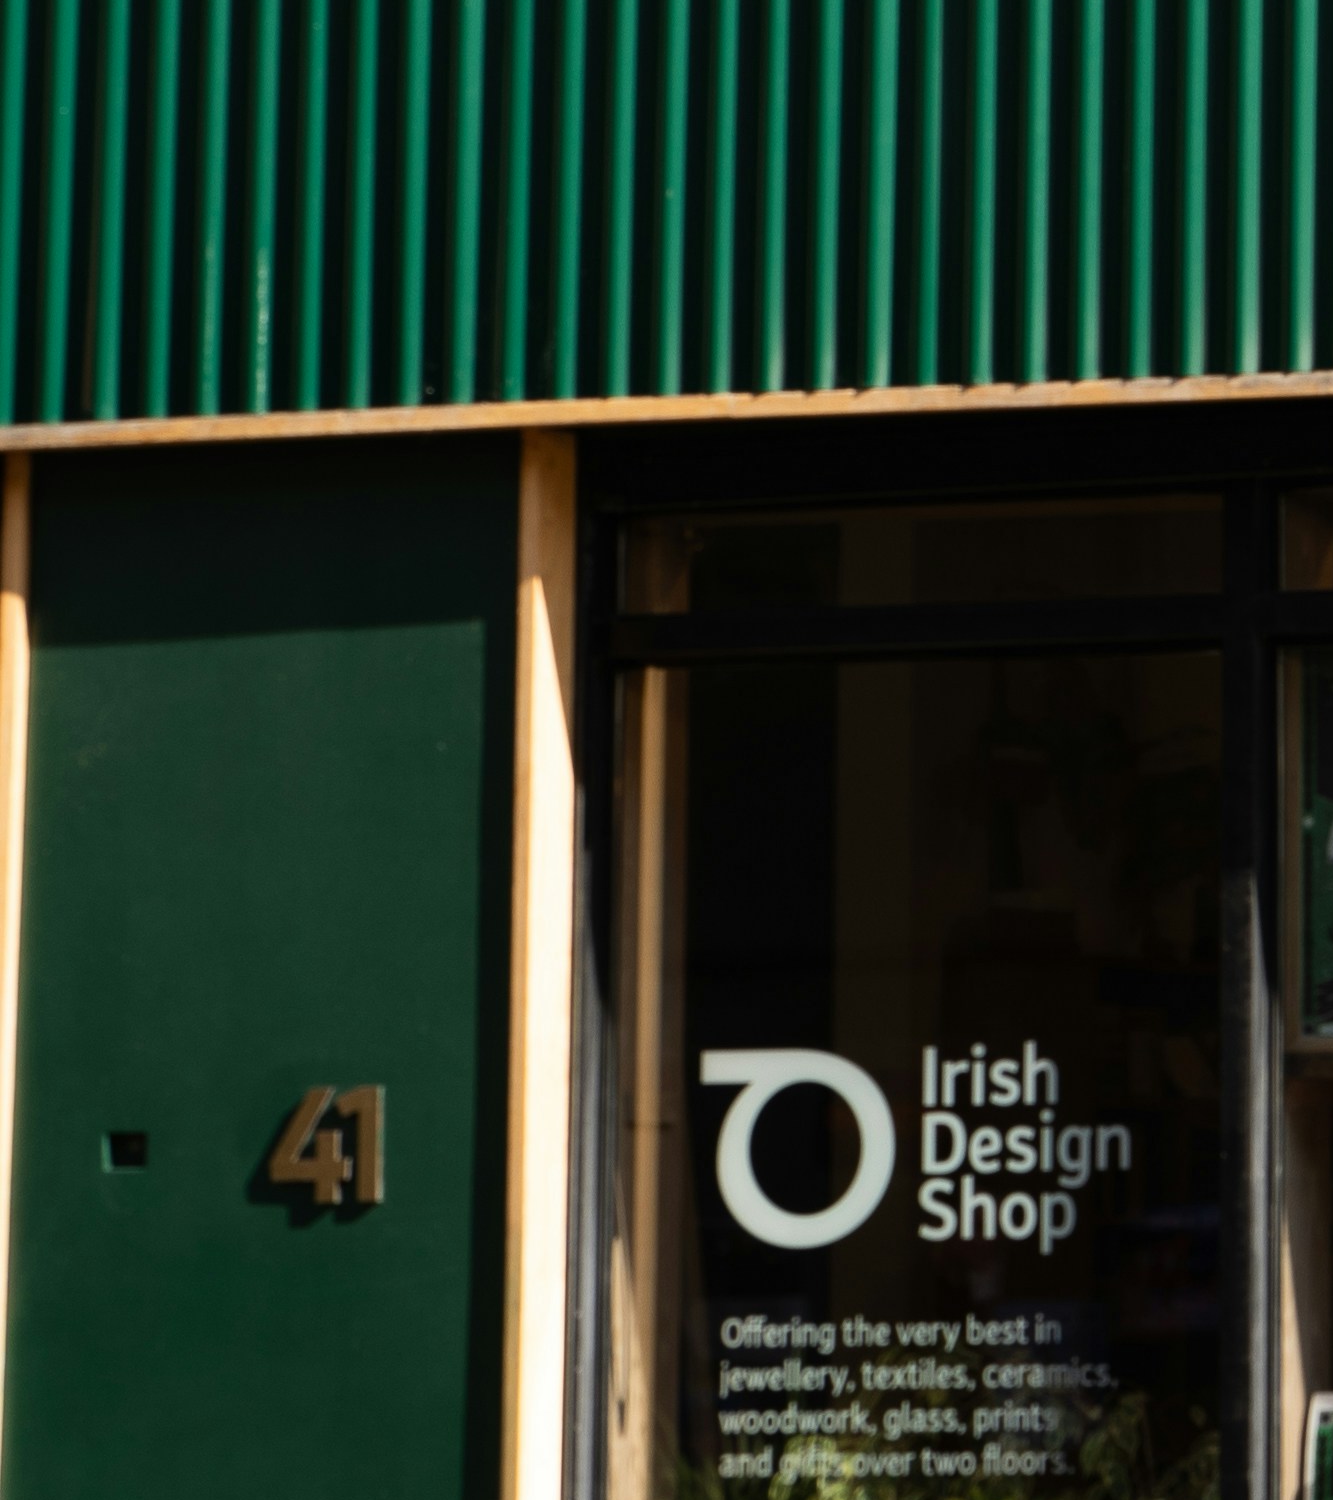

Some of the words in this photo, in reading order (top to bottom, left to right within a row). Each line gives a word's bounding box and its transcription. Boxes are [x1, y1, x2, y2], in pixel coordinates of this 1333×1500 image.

[921, 1039, 1060, 1107] Irish
[268, 1083, 387, 1205] 41
[920, 1109, 1133, 1189] Design
[918, 1174, 1078, 1256] Shop
[720, 1314, 837, 1356] Offering
[841, 1313, 892, 1347] the
[895, 1321, 961, 1353] very
[965, 1312, 1029, 1346] best
[1034, 1312, 1063, 1345] in
[719, 1359, 857, 1400] jewellery,
[861, 1356, 977, 1392] textiles,
[718, 1401, 878, 1437] woodwork,
[883, 1401, 967, 1441] glass,
[972, 1398, 1061, 1440] prints
[718, 1445, 774, 1479] and
[852, 1451, 916, 1478] over
[920, 1447, 977, 1477] two
